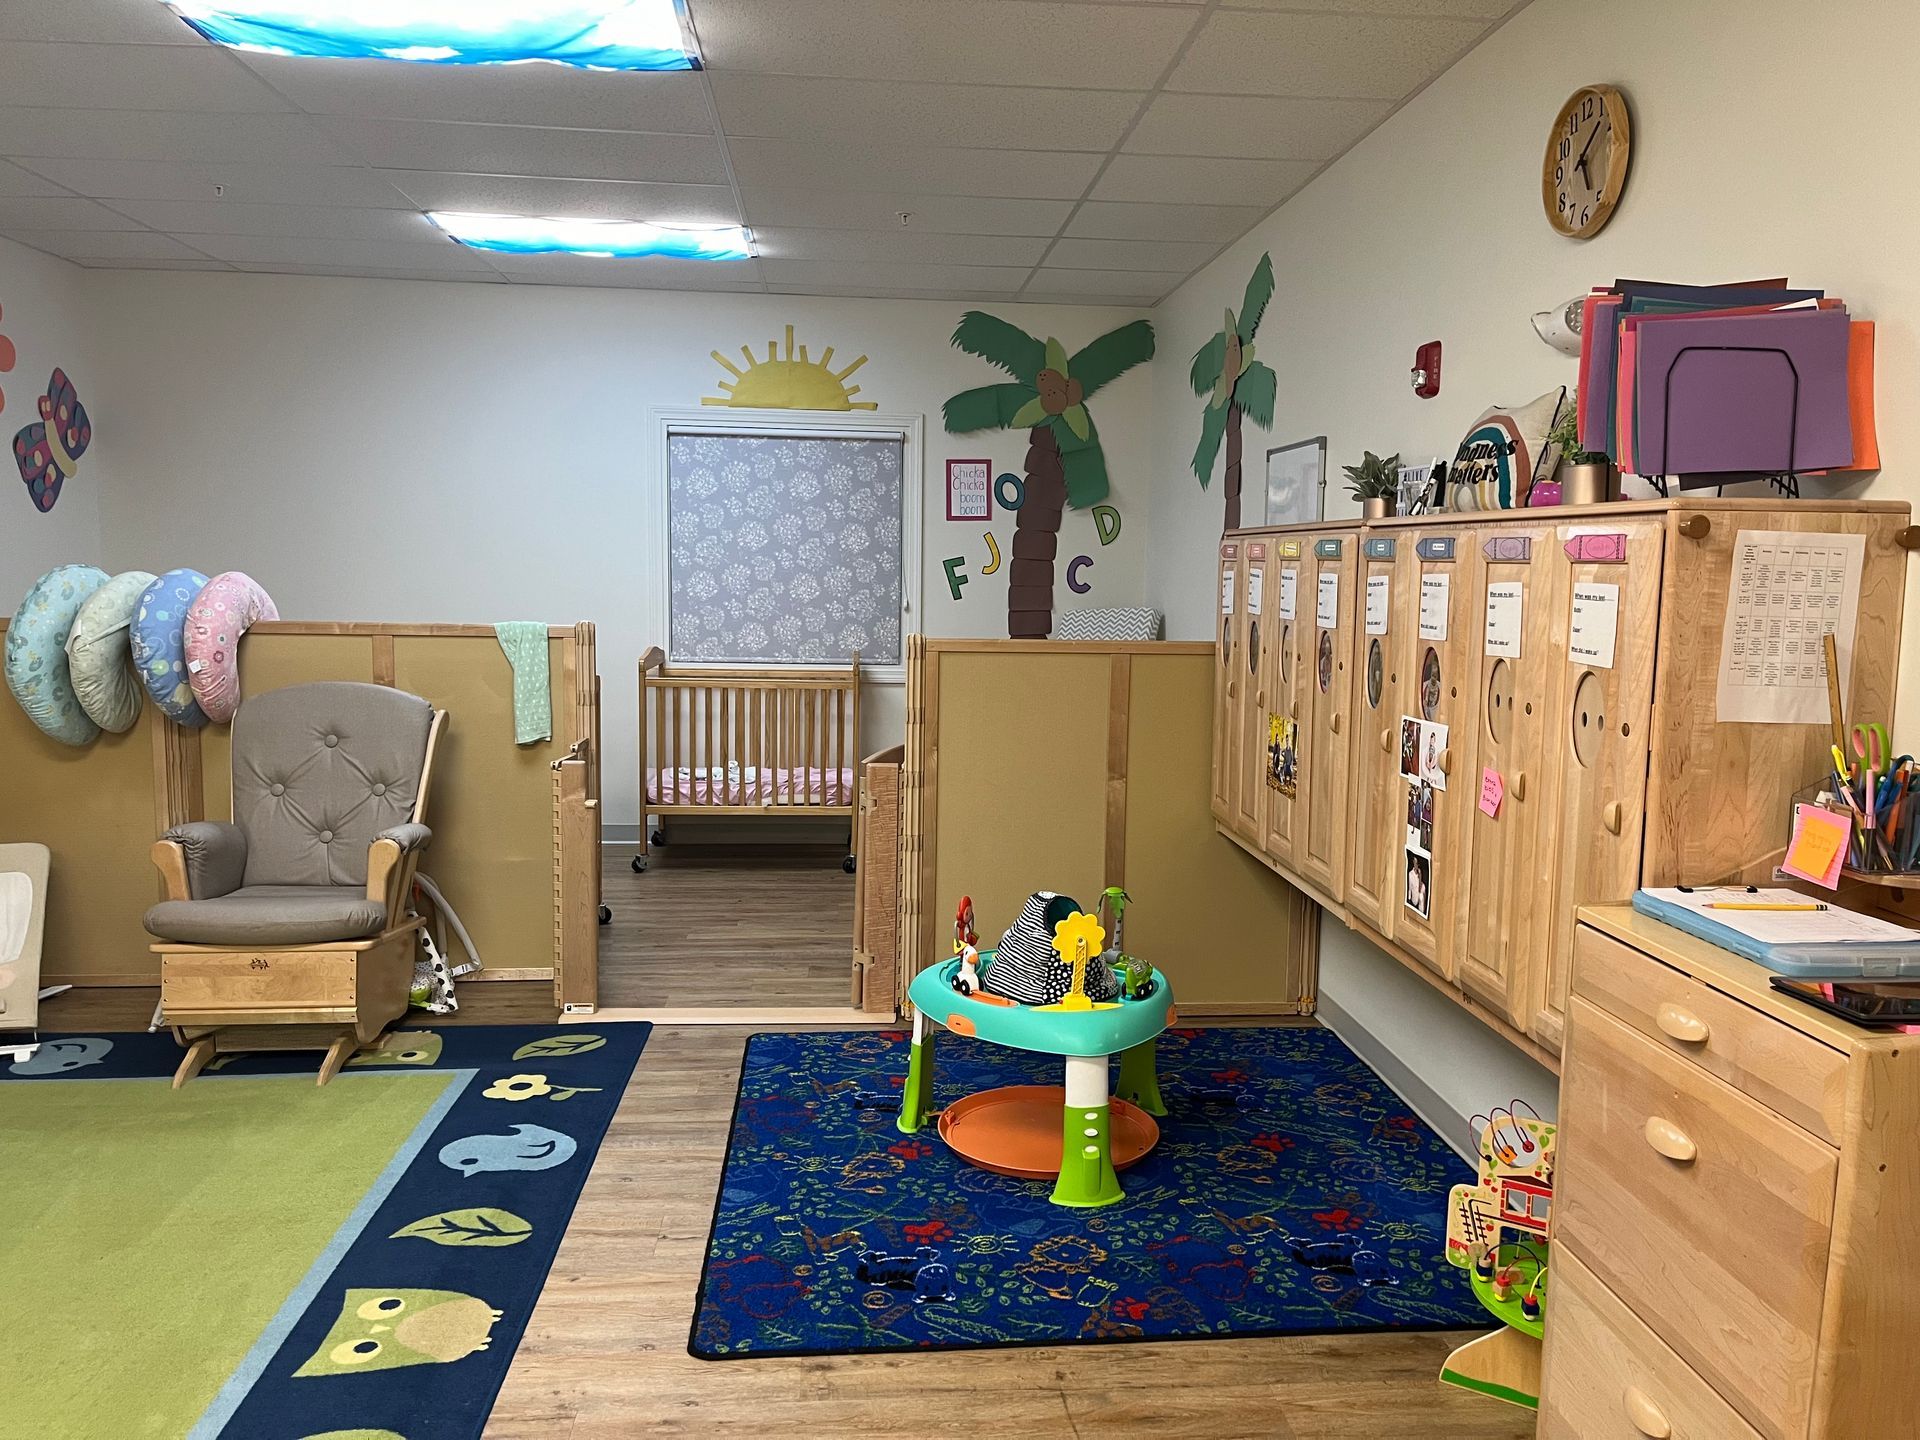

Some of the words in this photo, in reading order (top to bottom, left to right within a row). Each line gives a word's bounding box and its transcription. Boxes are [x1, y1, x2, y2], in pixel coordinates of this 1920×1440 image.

[1581, 97, 1593, 122] 12
[1599, 97, 1604, 118] 1
[1569, 112, 1579, 136] 11
[1559, 137, 1571, 162] 10
[1555, 166, 1564, 187] 9
[1558, 192, 1566, 213] 8
[1569, 203, 1577, 225] 7
[1580, 205, 1589, 226] 6
[952, 465, 985, 478] Chicka
[952, 477, 985, 490] Chicka
[994, 473, 1025, 511] O
[960, 490, 985, 503] boom
[960, 503, 986, 515] boom
[1092, 505, 1122, 546] D
[981, 532, 1001, 575] J
[942, 556, 969, 600] F
[1066, 555, 1094, 594] C
